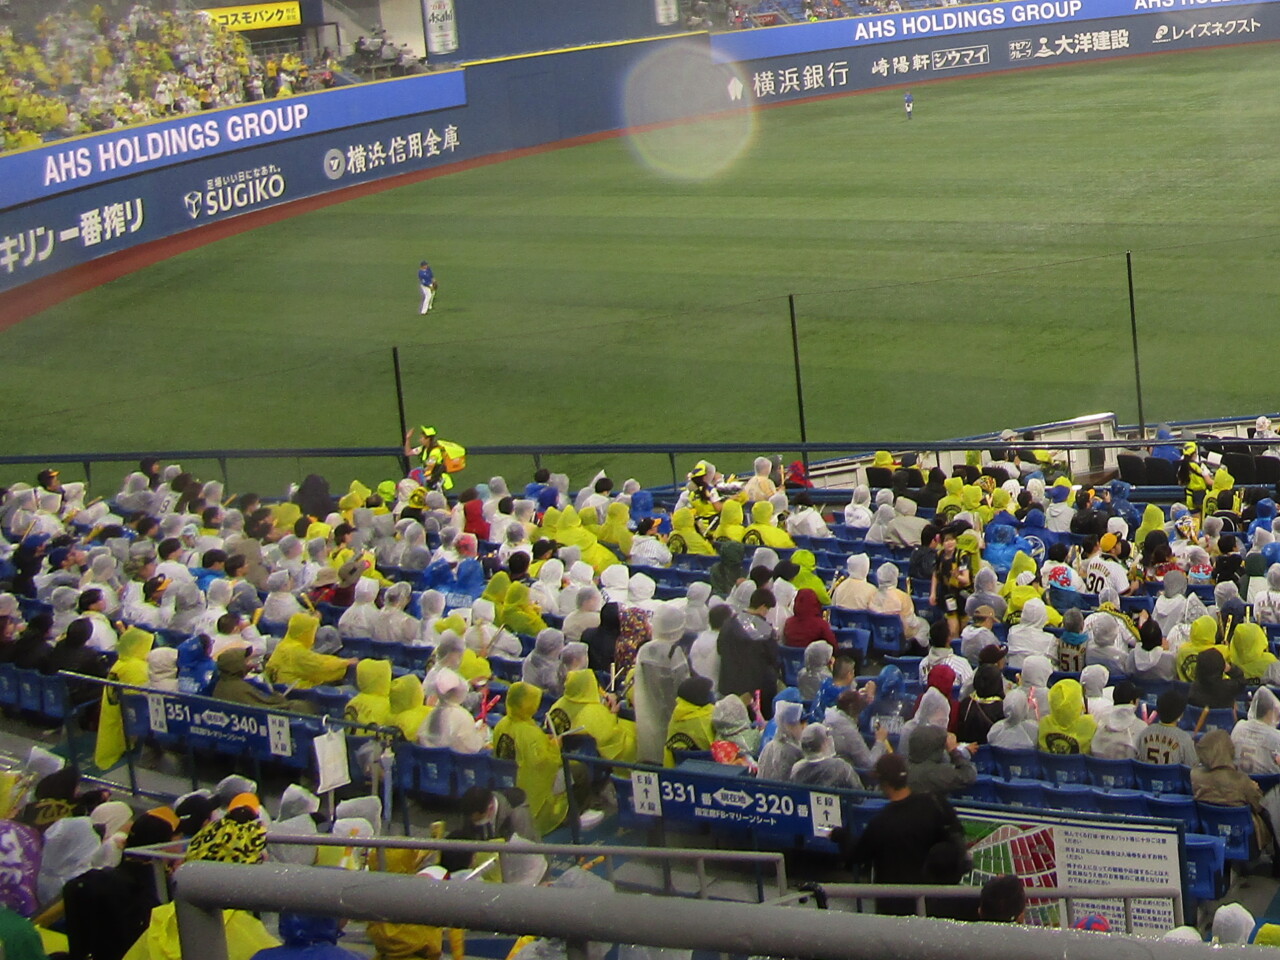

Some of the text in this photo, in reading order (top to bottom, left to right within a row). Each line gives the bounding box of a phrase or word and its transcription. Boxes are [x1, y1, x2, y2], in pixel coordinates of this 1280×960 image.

[218, 8, 286, 26] コスモバンク
[429, 8, 454, 24] Asahi
[854, 0, 1082, 41] AHS HOLDINGS GROUP
[1172, 17, 1261, 40] レイズネクスト
[1054, 29, 1130, 56] 大洋建設
[871, 47, 989, 77] 崎陽軒 シウマイ
[753, 60, 850, 98] 横浜銀行
[44, 103, 309, 187] AHS HOLDINGS GROUP
[347, 123, 461, 176] 横浜信用金庫
[206, 173, 286, 216] SUGIKO
[0, 197, 145, 274] キリン一番搾り
[1086, 572, 1105, 595] 30
[1060, 653, 1080, 673] 51
[166, 702, 258, 734] 351 340
[1146, 747, 1171, 765] 51
[661, 780, 696, 804] 331
[755, 792, 794, 816] 320
